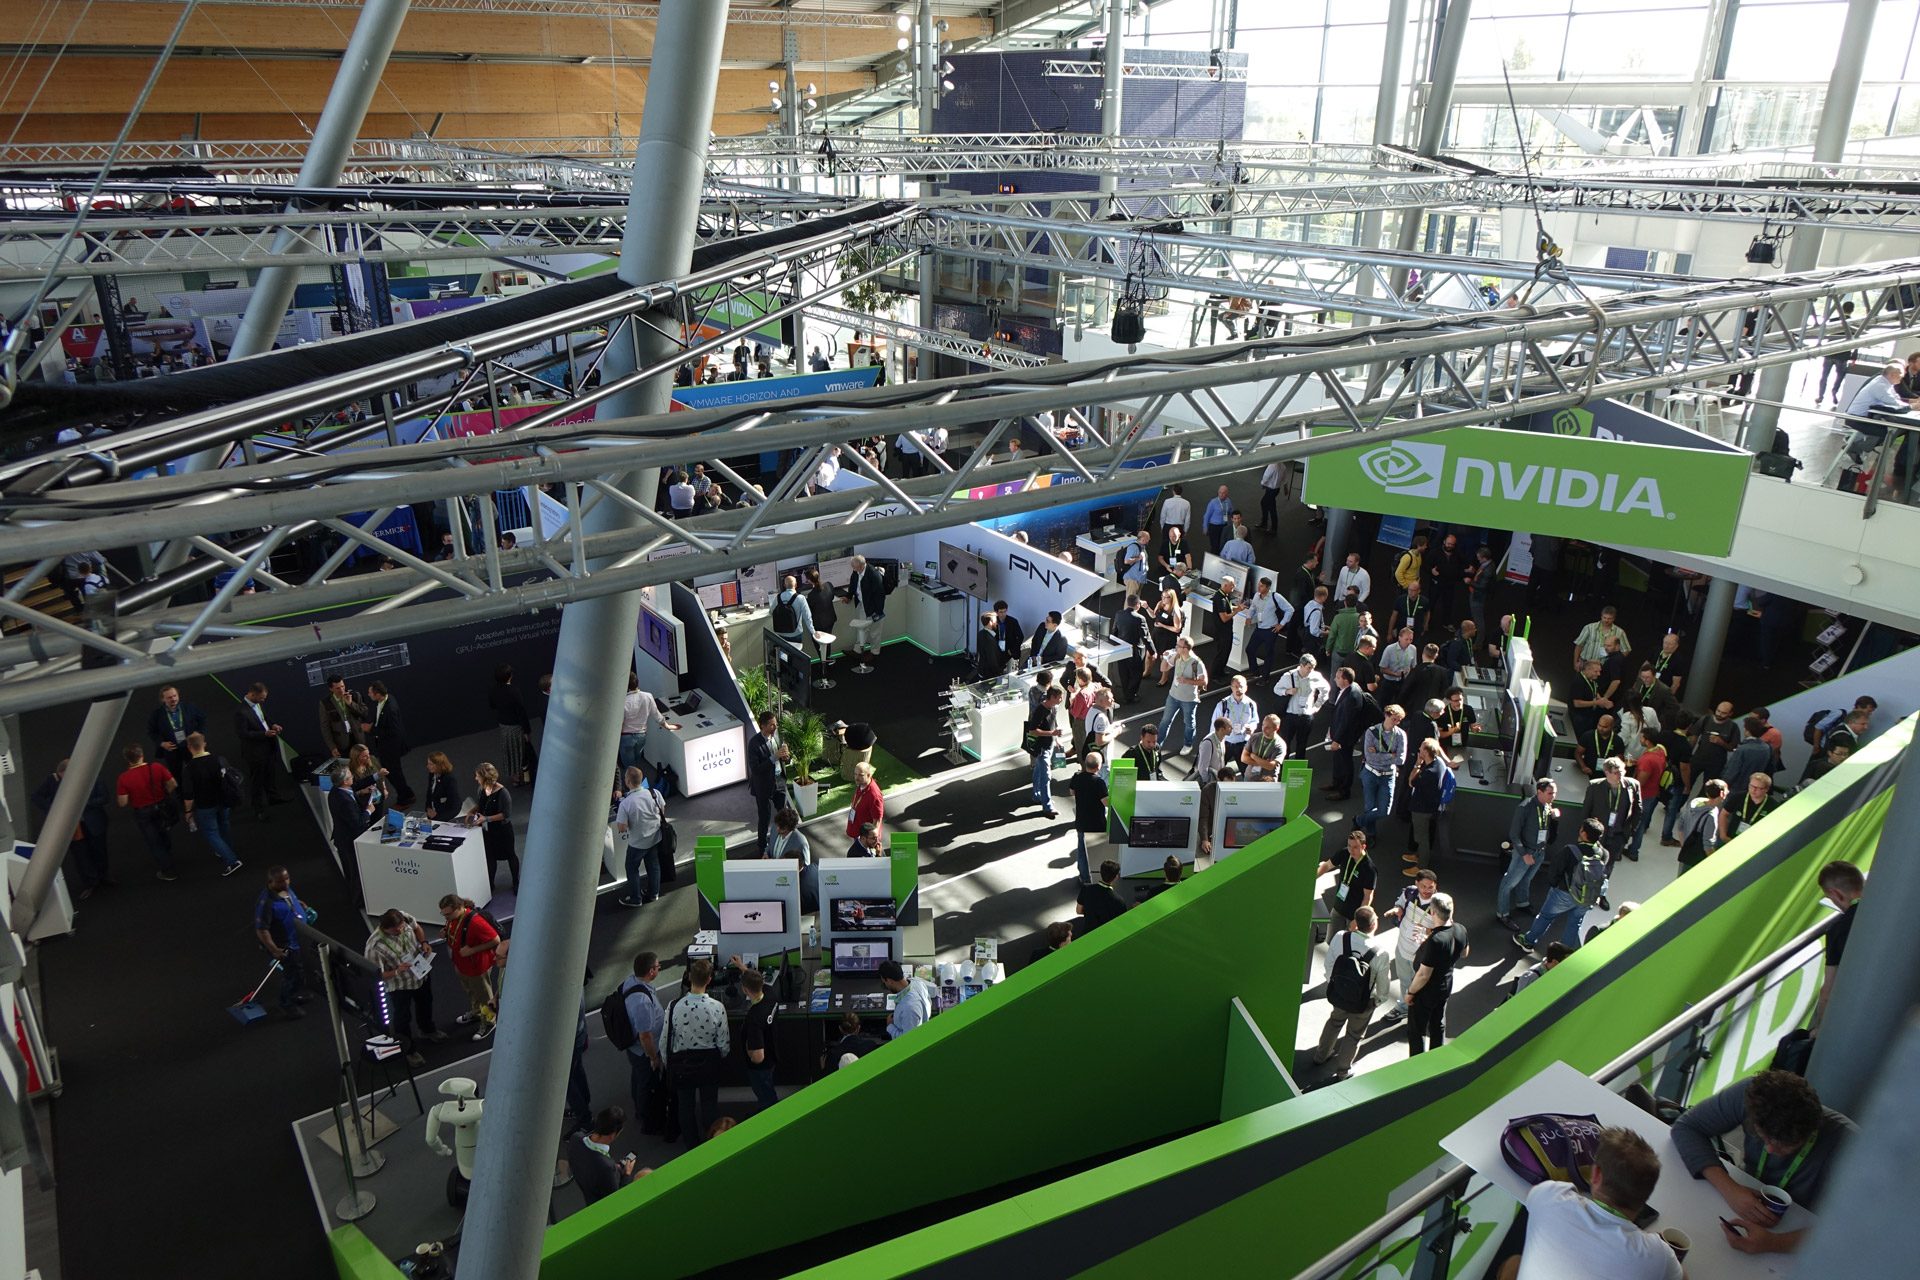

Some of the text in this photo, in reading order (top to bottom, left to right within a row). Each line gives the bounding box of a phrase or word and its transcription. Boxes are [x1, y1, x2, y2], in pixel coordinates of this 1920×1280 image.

[825, 381, 864, 392] vmware
[690, 387, 800, 408] VMWARE HORIZON AND
[1452, 457, 1666, 518] NVIDIA
[864, 507, 898, 521] PNY
[1009, 553, 1071, 592] PNY
[702, 757, 731, 771] CISCO
[395, 866, 419, 875] CISCO
